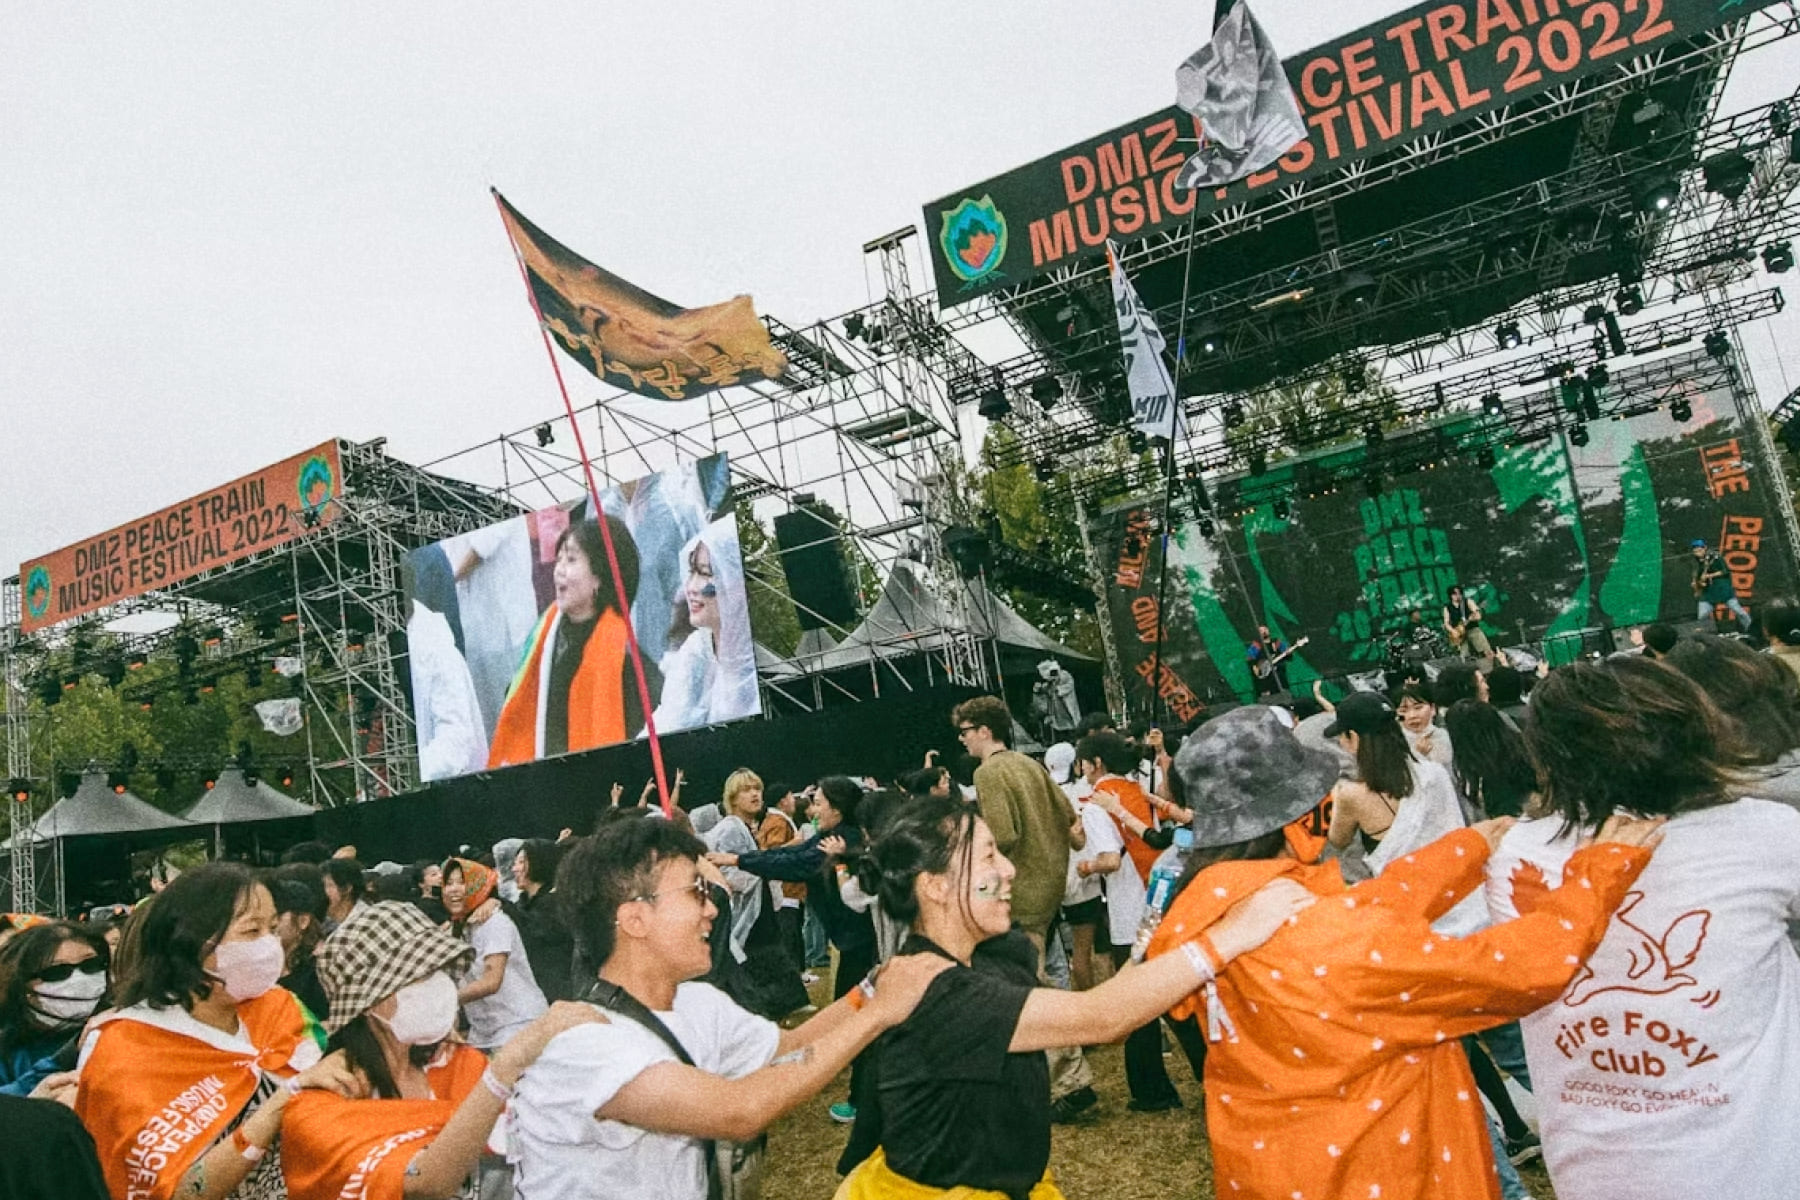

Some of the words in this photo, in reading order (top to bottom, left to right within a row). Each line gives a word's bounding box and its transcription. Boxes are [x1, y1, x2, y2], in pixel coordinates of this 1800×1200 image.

[1028, 166, 1198, 267] MUSIC
[1496, 0, 1675, 93] 2022
[1060, 118, 1185, 204] DMZ
[1705, 437, 1750, 497] THE
[58, 565, 124, 614] MUSIC
[128, 527, 228, 589] FESTIVAL
[231, 502, 290, 552] 2022
[75, 534, 121, 578] DMZ
[125, 505, 194, 558] PEACE
[197, 477, 266, 529] TRAIN
[1555, 1016, 1610, 1060] Fire
